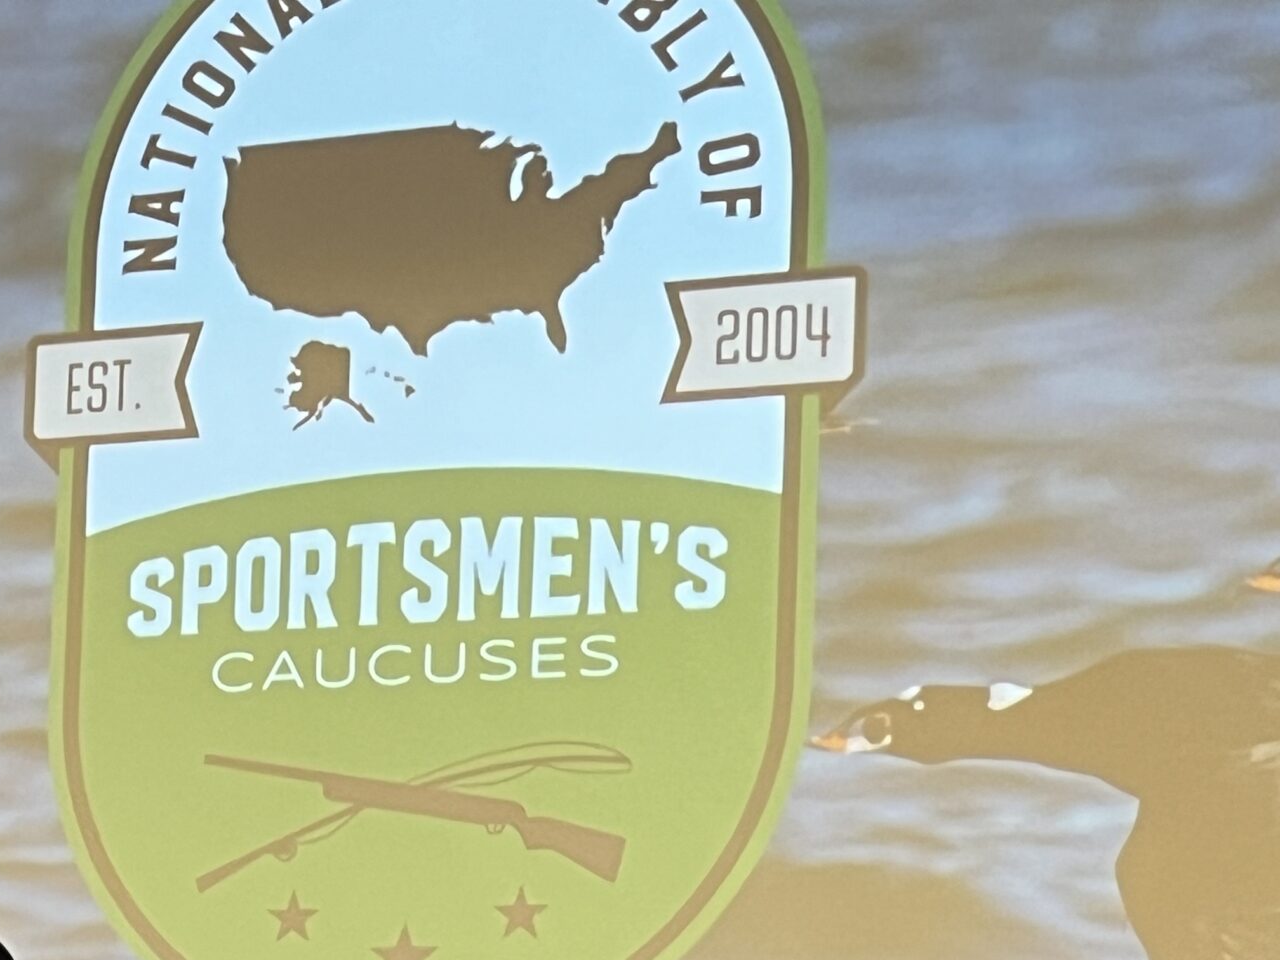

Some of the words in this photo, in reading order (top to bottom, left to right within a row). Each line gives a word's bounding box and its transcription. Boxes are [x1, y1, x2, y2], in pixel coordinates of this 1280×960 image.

[122, 0, 341, 275] NATIONA
[698, 133, 762, 218] OF
[716, 303, 831, 365] 2004
[67, 359, 141, 415] EST.
[127, 516, 728, 638] SPORTSMEN'S
[212, 635, 618, 693] CAUCUSES
